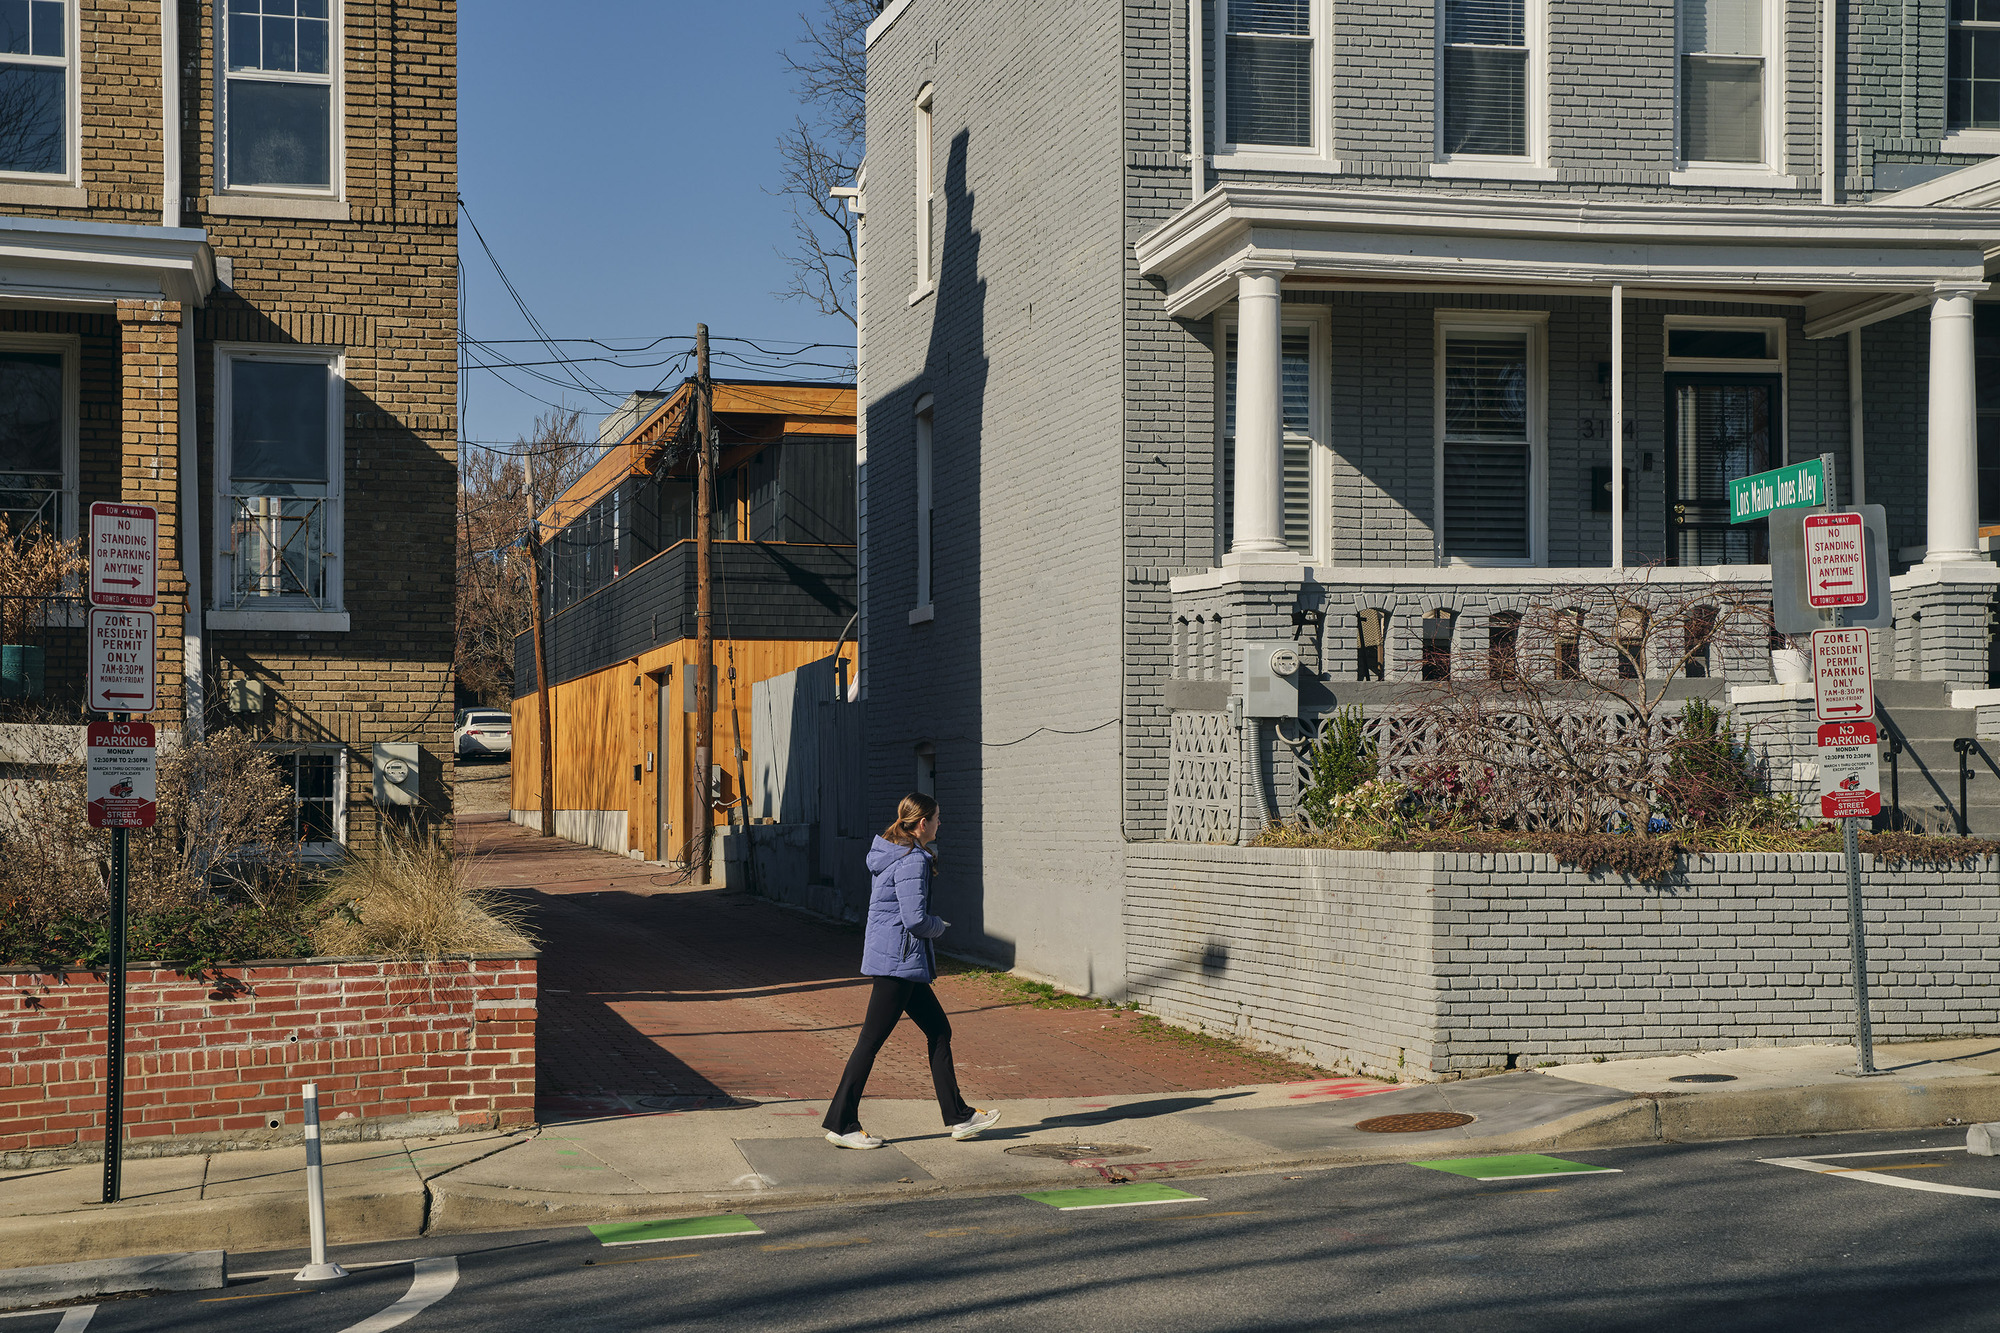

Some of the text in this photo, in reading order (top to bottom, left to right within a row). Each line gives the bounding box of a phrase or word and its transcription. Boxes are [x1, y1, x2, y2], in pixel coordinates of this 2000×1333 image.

[1736, 468, 1816, 516] Lois Mailou Jones Alley
[118, 520, 130, 530] NO
[1828, 529, 1839, 537] NO
[102, 533, 146, 546] STANDING
[1815, 541, 1854, 552] STANDING
[97, 549, 150, 560] OR PARKING
[1824, 553, 1859, 563] PARKING
[104, 563, 144, 574] ANYTIME
[1819, 567, 1854, 577] ANYTIME
[105, 616, 140, 627] ZONE 1
[97, 628, 148, 639] RESIDENT
[1824, 634, 1858, 644] ZONE 1
[103, 640, 142, 650] PERMIT
[1820, 645, 1862, 655] RESIDENT
[108, 652, 137, 662] ONLY
[1827, 657, 1857, 667] PERMIT
[102, 664, 143, 674] 7AM-8:30PM
[1821, 667, 1864, 677] PARKING
[1833, 678, 1853, 688] ONLY
[113, 725, 130, 734] NO
[1840, 726, 1854, 734] NO
[96, 736, 148, 746] PARKING
[1825, 735, 1870, 745] PARKING
